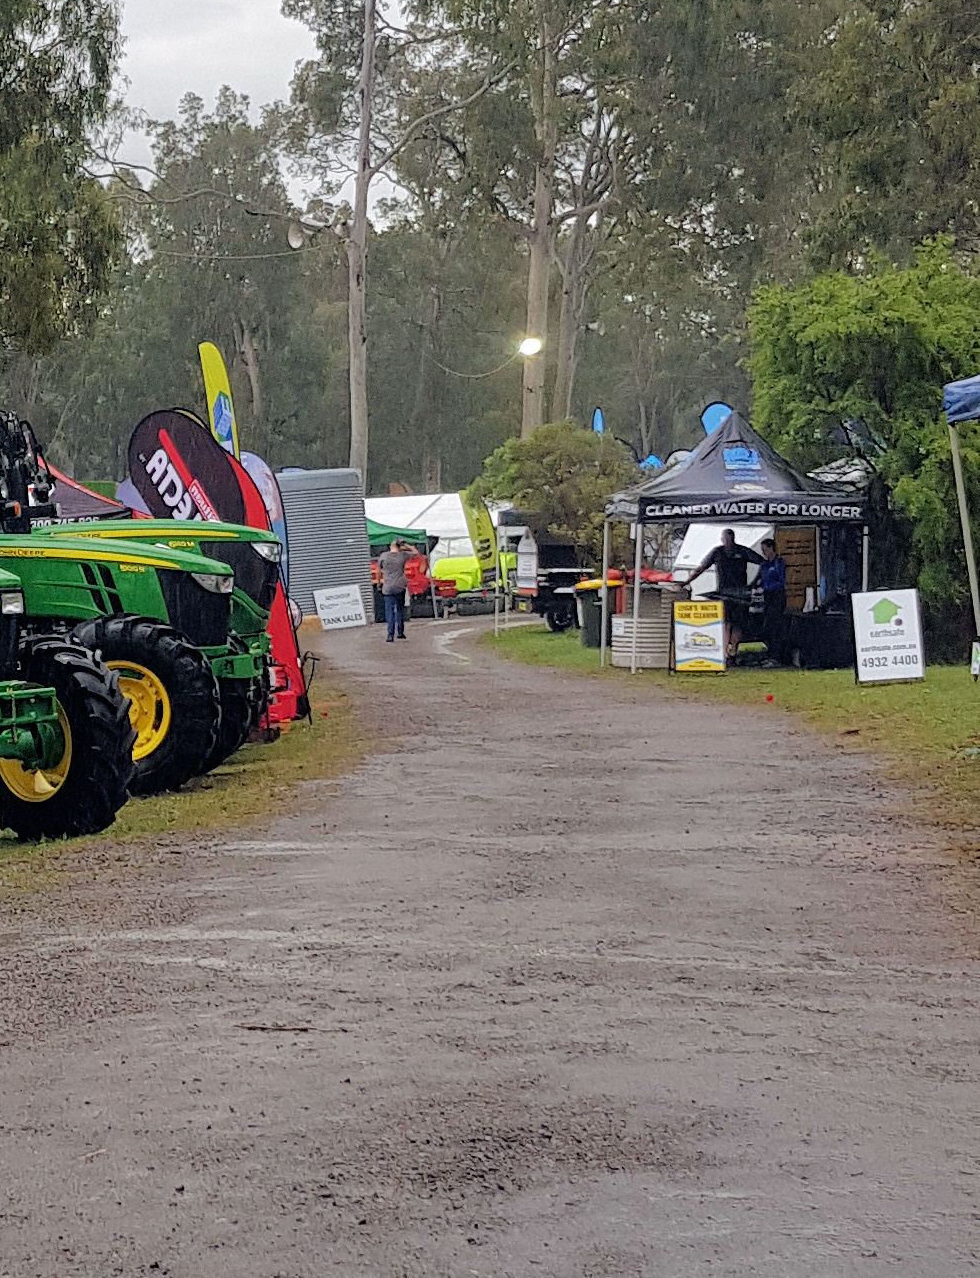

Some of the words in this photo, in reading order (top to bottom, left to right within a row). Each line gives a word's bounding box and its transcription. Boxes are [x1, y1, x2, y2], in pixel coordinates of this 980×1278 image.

[645, 504, 710, 516] CLEANER
[714, 502, 765, 515] WATER
[769, 503, 798, 515] FOR
[801, 504, 861, 518] LONGER
[861, 656, 888, 668] 4932
[891, 654, 918, 666] 4400
